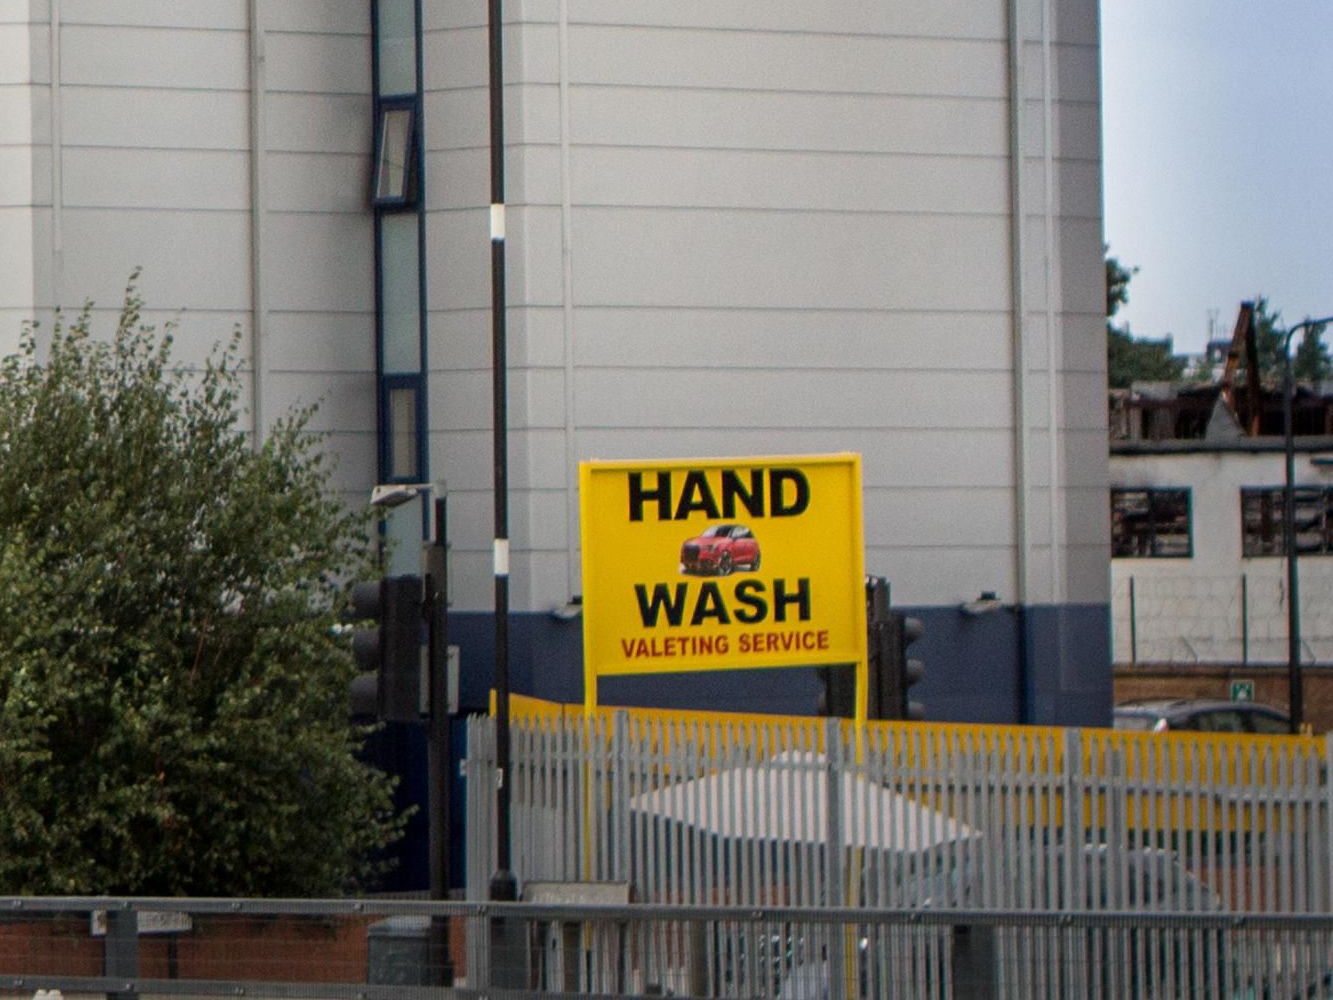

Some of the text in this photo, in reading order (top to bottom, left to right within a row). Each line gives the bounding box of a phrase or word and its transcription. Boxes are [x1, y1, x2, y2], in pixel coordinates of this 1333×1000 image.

[628, 466, 810, 522] HAND
[634, 577, 811, 628] WASH
[622, 630, 829, 658] VALETING SERVICE
